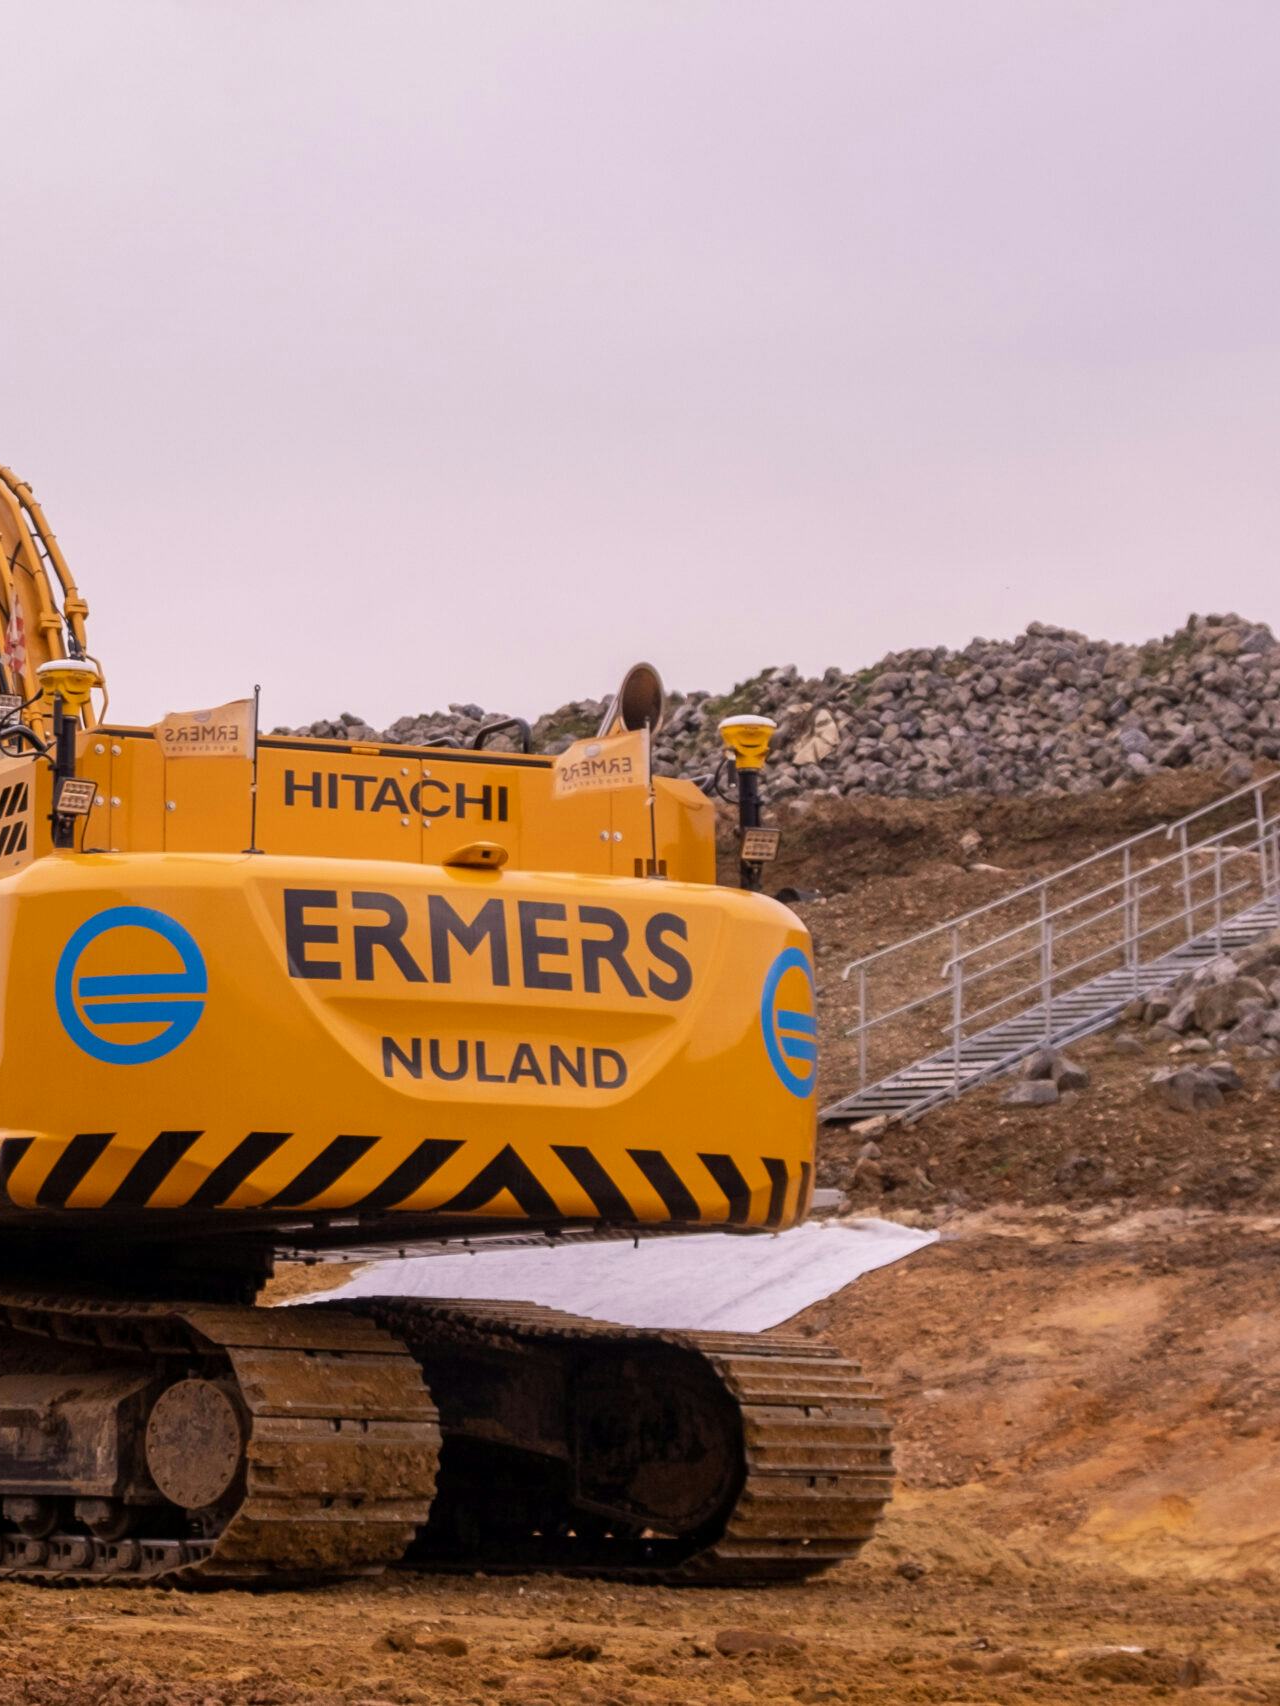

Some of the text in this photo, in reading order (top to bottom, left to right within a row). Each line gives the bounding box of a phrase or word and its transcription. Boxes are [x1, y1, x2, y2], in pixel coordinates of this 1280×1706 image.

[284, 769, 509, 822] HITACHI
[283, 888, 694, 1001] ERMERS
[380, 1036, 629, 1091] NULAND
